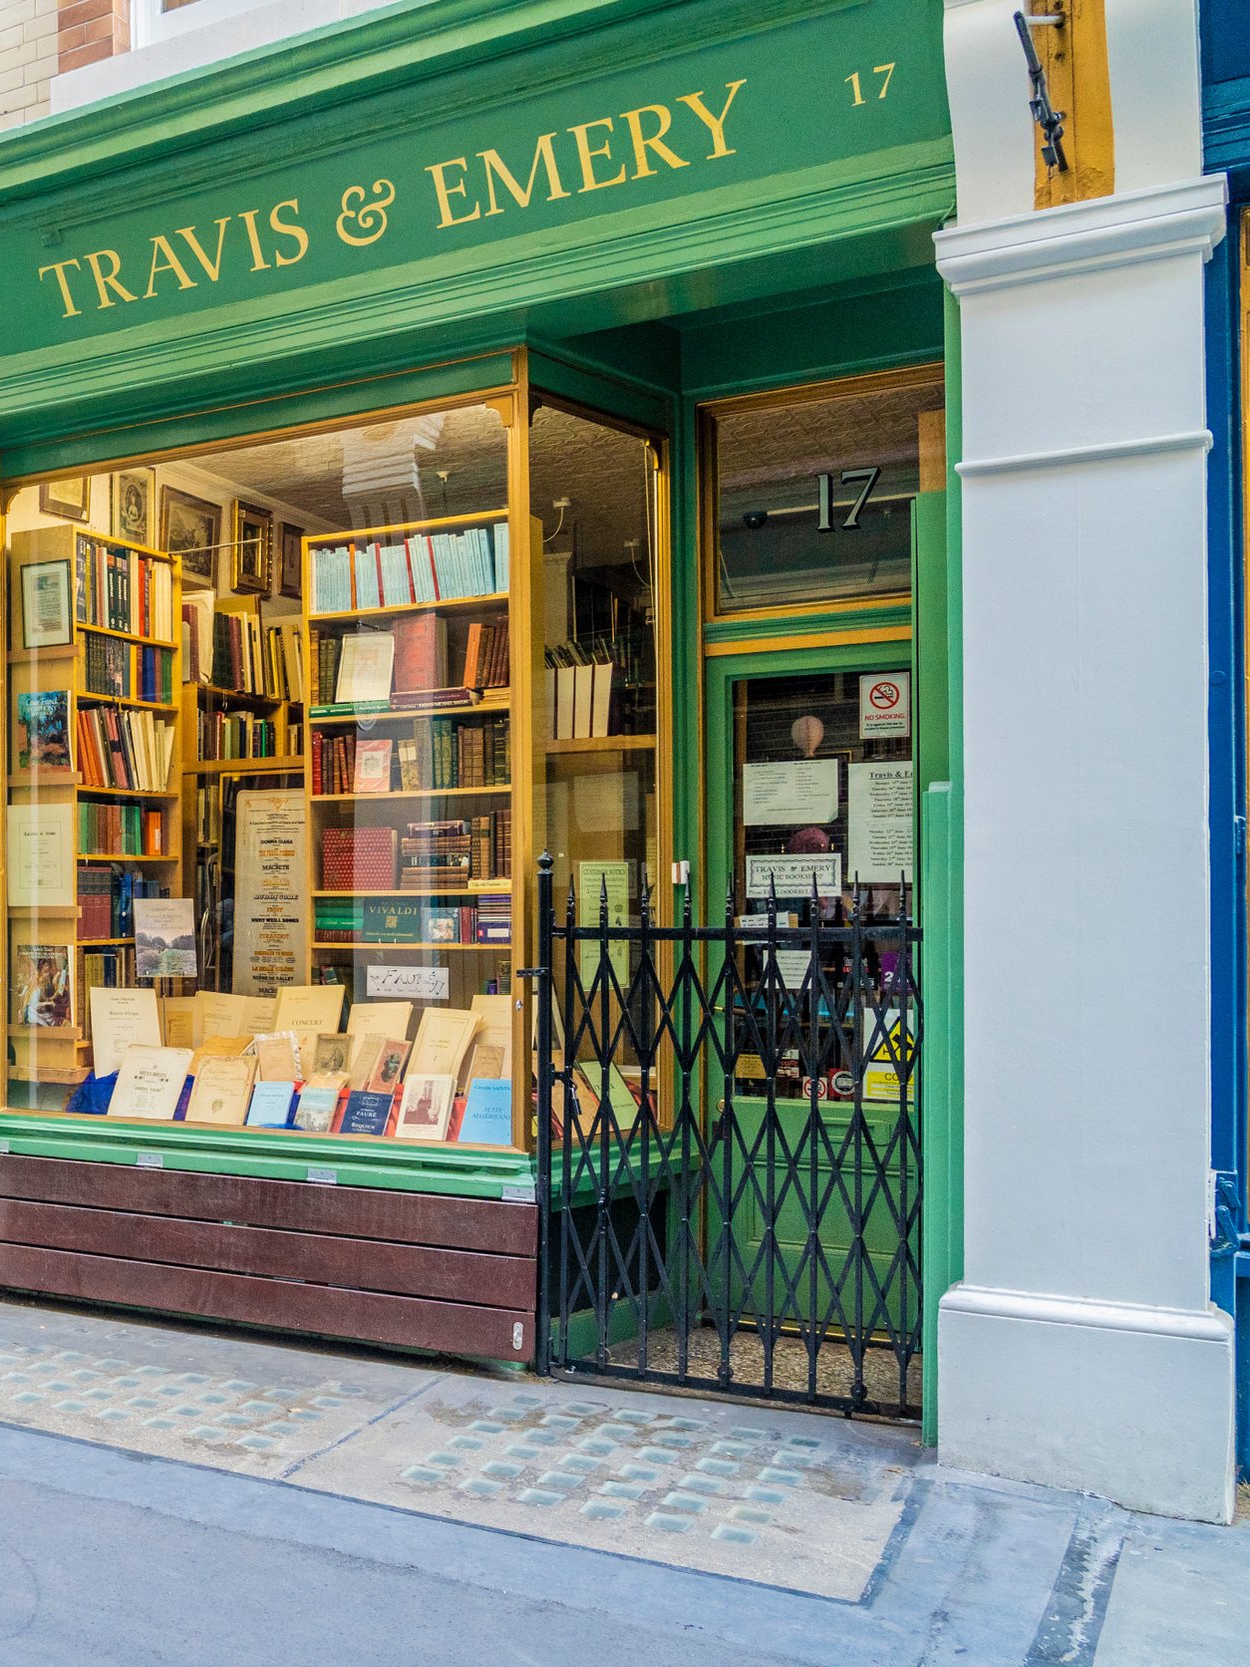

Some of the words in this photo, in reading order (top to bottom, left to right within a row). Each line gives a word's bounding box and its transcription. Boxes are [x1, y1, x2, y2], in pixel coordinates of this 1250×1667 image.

[843, 62, 896, 107] 17
[38, 197, 309, 318] TRAVIS
[335, 178, 395, 246] &
[424, 79, 748, 229] EMERY
[816, 467, 881, 533] 17
[875, 712, 905, 720] SMOKING
[755, 865, 786, 873] TRAVIS
[370, 906, 417, 915] VIVALDI
[471, 1112, 511, 1120] ALGÉRIENN
